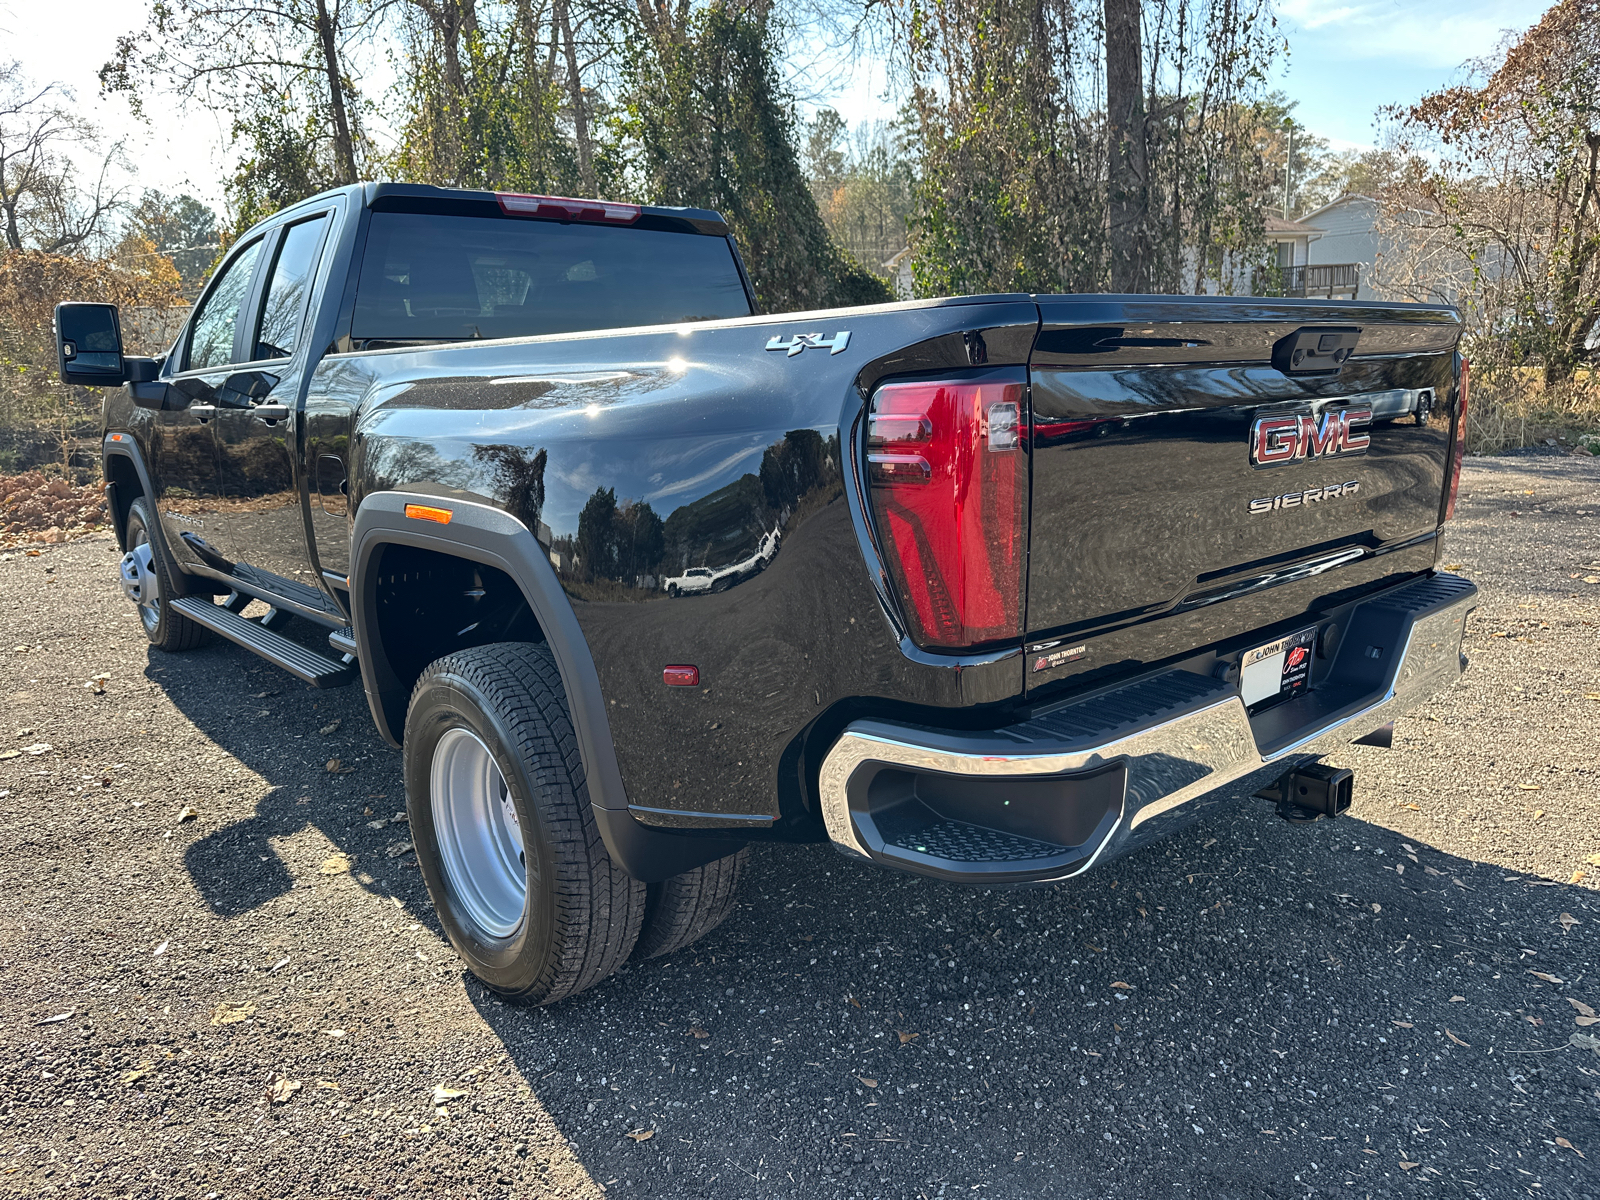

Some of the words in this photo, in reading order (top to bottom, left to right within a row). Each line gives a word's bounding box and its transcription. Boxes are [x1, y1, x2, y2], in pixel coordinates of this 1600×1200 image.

[1254, 410, 1373, 465] GMC
[1247, 480, 1360, 514] SIERRA
[1048, 652, 1061, 662] JOHN
[1061, 644, 1085, 657] THORNTON
[1261, 645, 1280, 657] JOHN
[1281, 630, 1316, 650] THORNON
